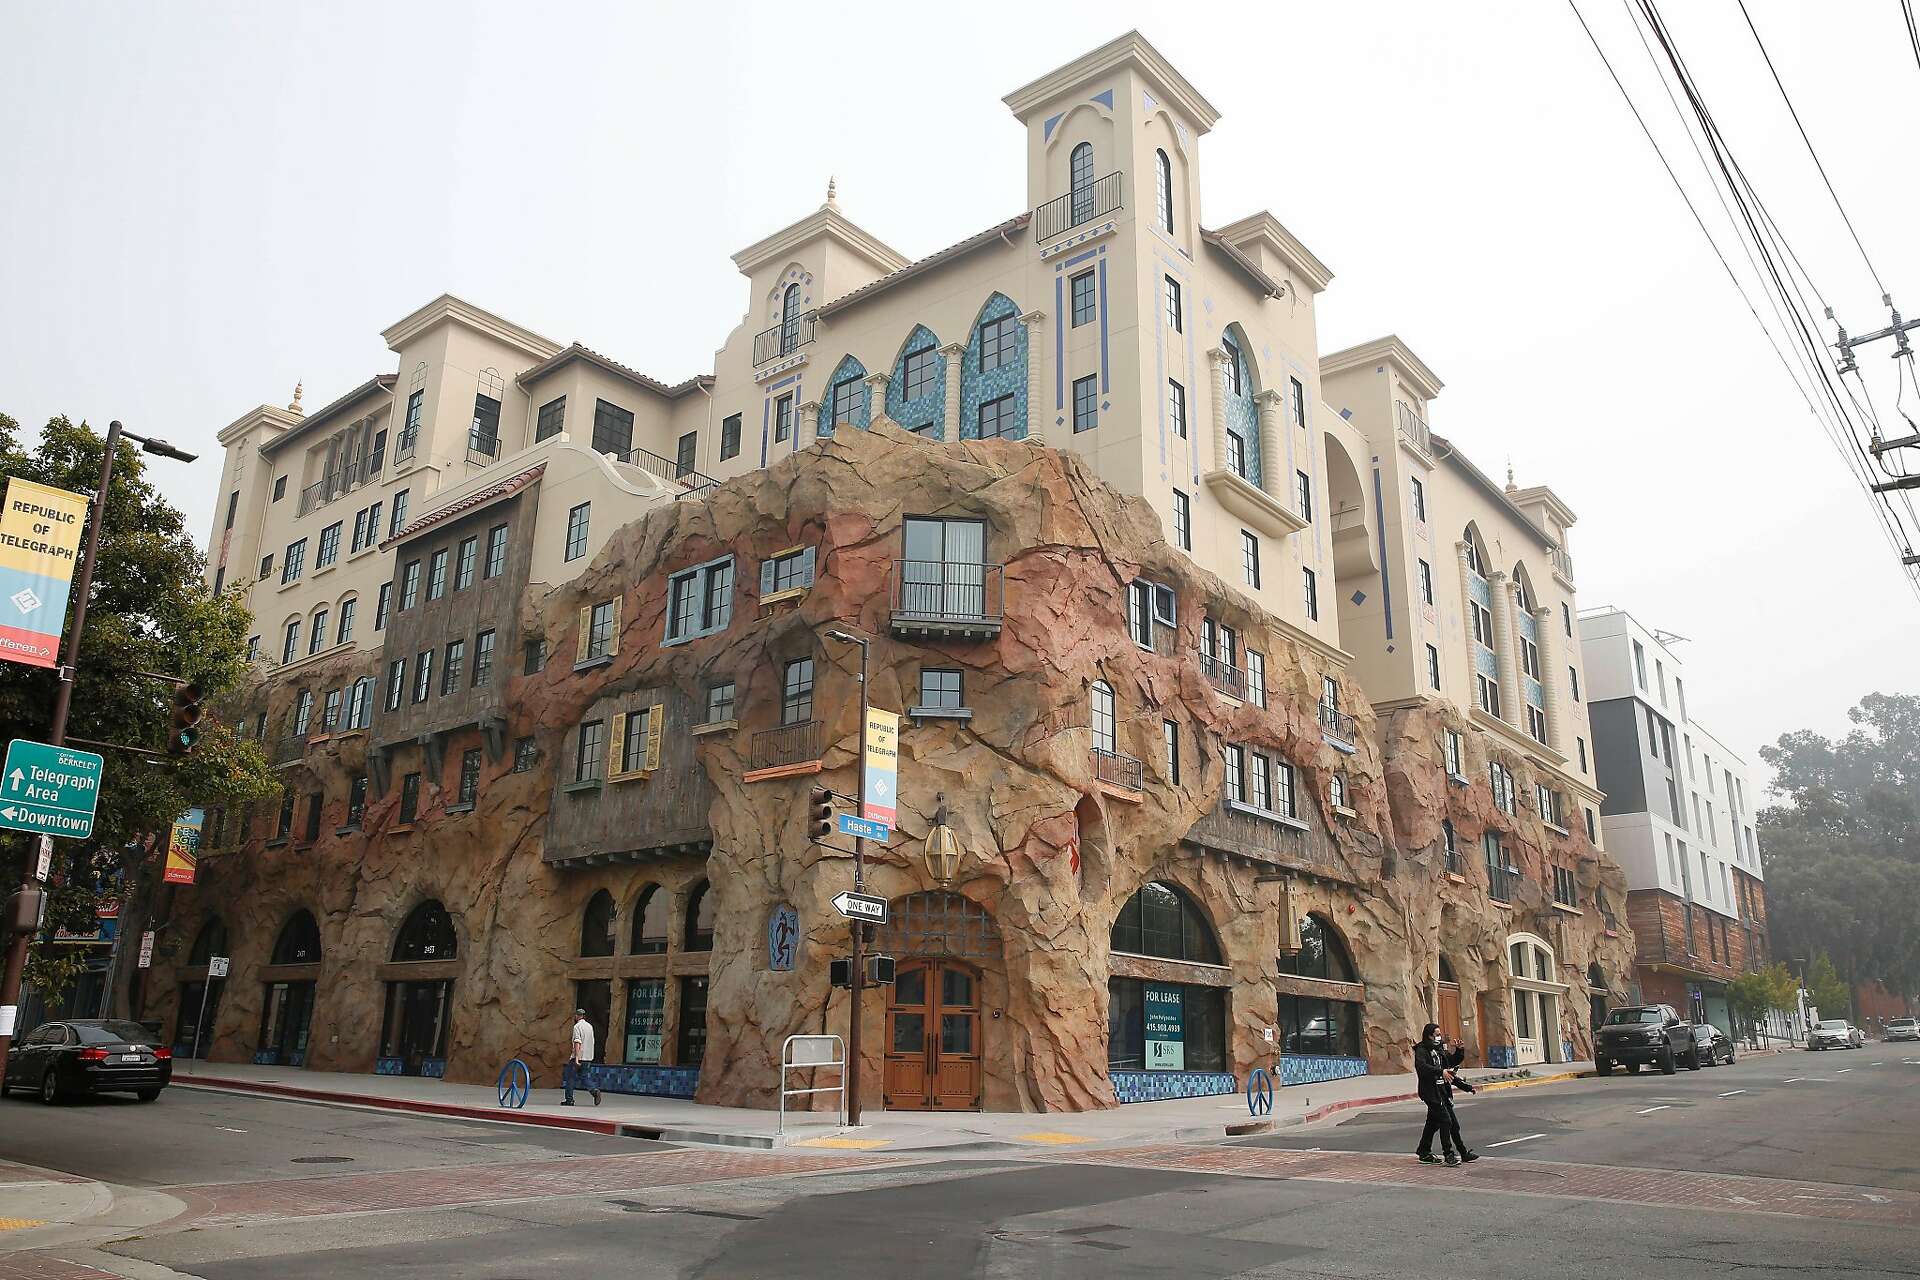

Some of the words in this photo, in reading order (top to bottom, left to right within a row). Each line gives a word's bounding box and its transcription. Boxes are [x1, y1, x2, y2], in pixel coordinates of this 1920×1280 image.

[13, 501, 76, 525] REPUBLIC
[32, 523, 51, 535] OF
[0, 533, 74, 560] TELEGRAPH
[869, 721, 894, 734] REPUBLIC
[878, 735, 886, 743] OF
[867, 744, 896, 758] TELEGRAPH
[58, 757, 97, 770] BERKELEY
[30, 765, 95, 792] Telegraph
[24, 783, 59, 802] Area
[18, 807, 89, 832] Downtown
[847, 819, 872, 834] Haste
[847, 900, 863, 911] ONE
[864, 903, 880, 914] WAY
[632, 988, 647, 998] FOR
[1146, 990, 1159, 1002] FOR
[1160, 992, 1180, 1004] LEASE
